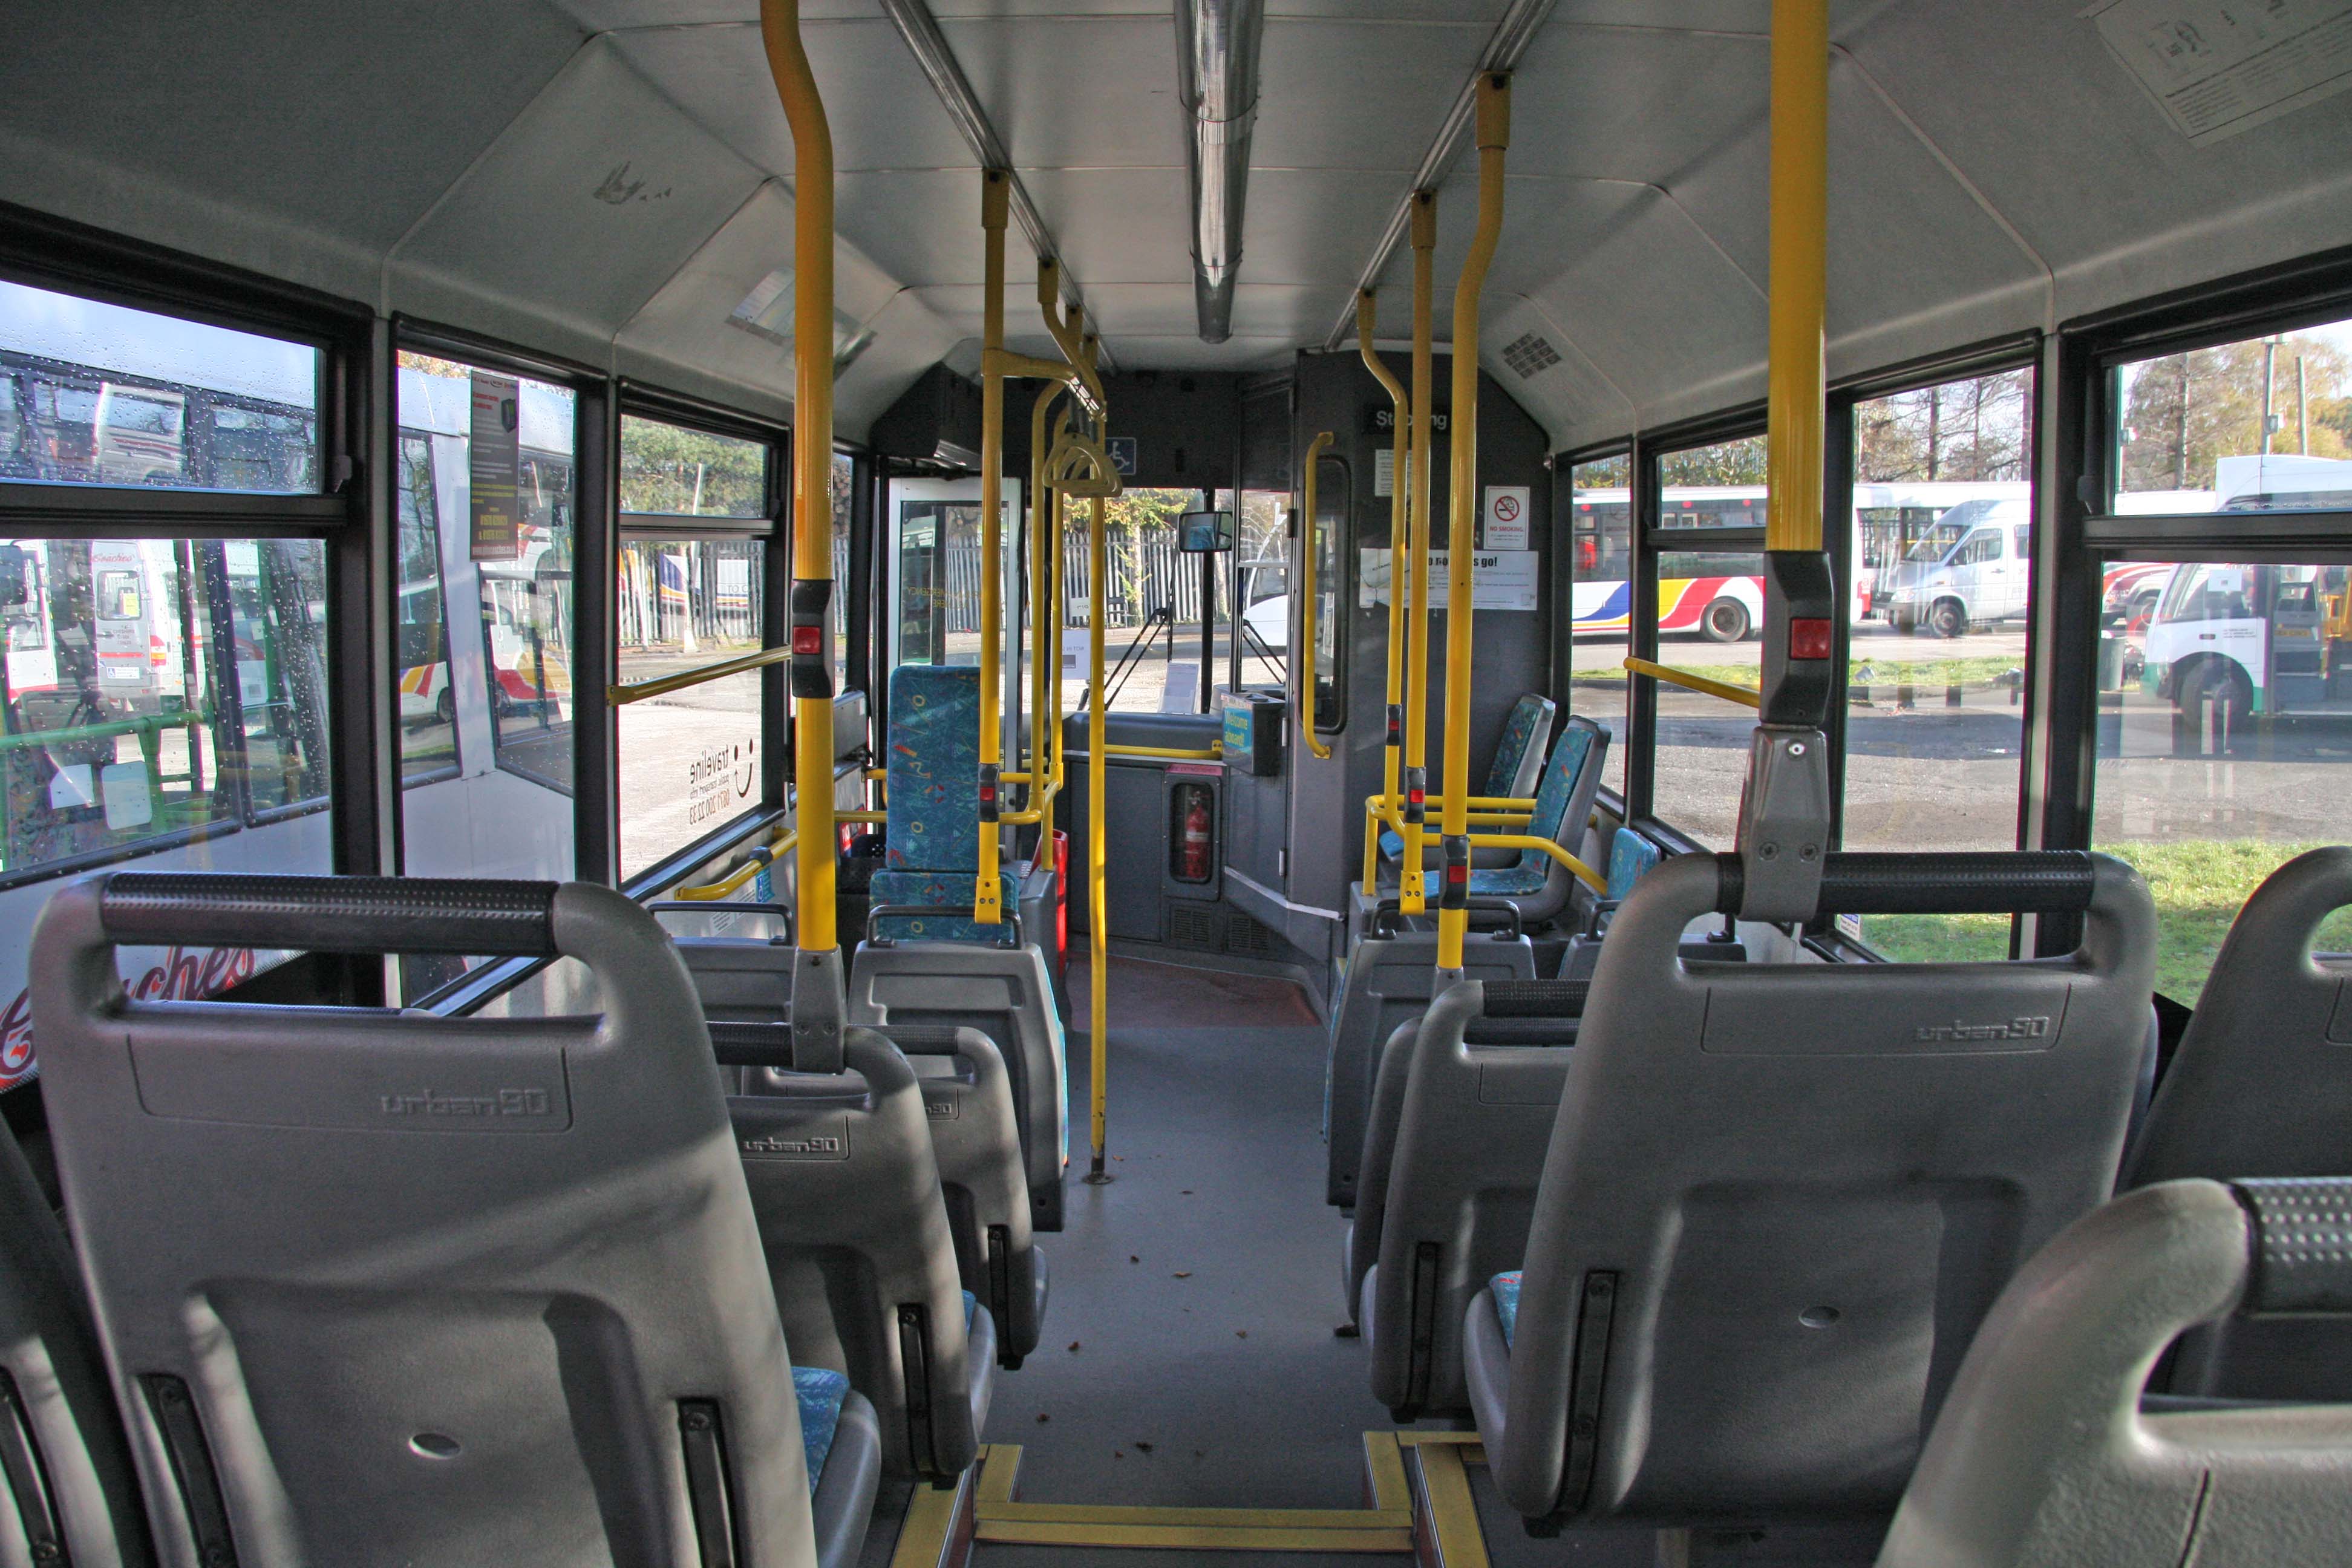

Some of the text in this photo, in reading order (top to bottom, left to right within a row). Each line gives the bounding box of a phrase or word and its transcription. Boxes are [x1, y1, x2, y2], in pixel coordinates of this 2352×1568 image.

[1376, 411, 1447, 430] Stng
[1481, 557, 1498, 568] go!
[1224, 711, 1247, 730] Welcome
